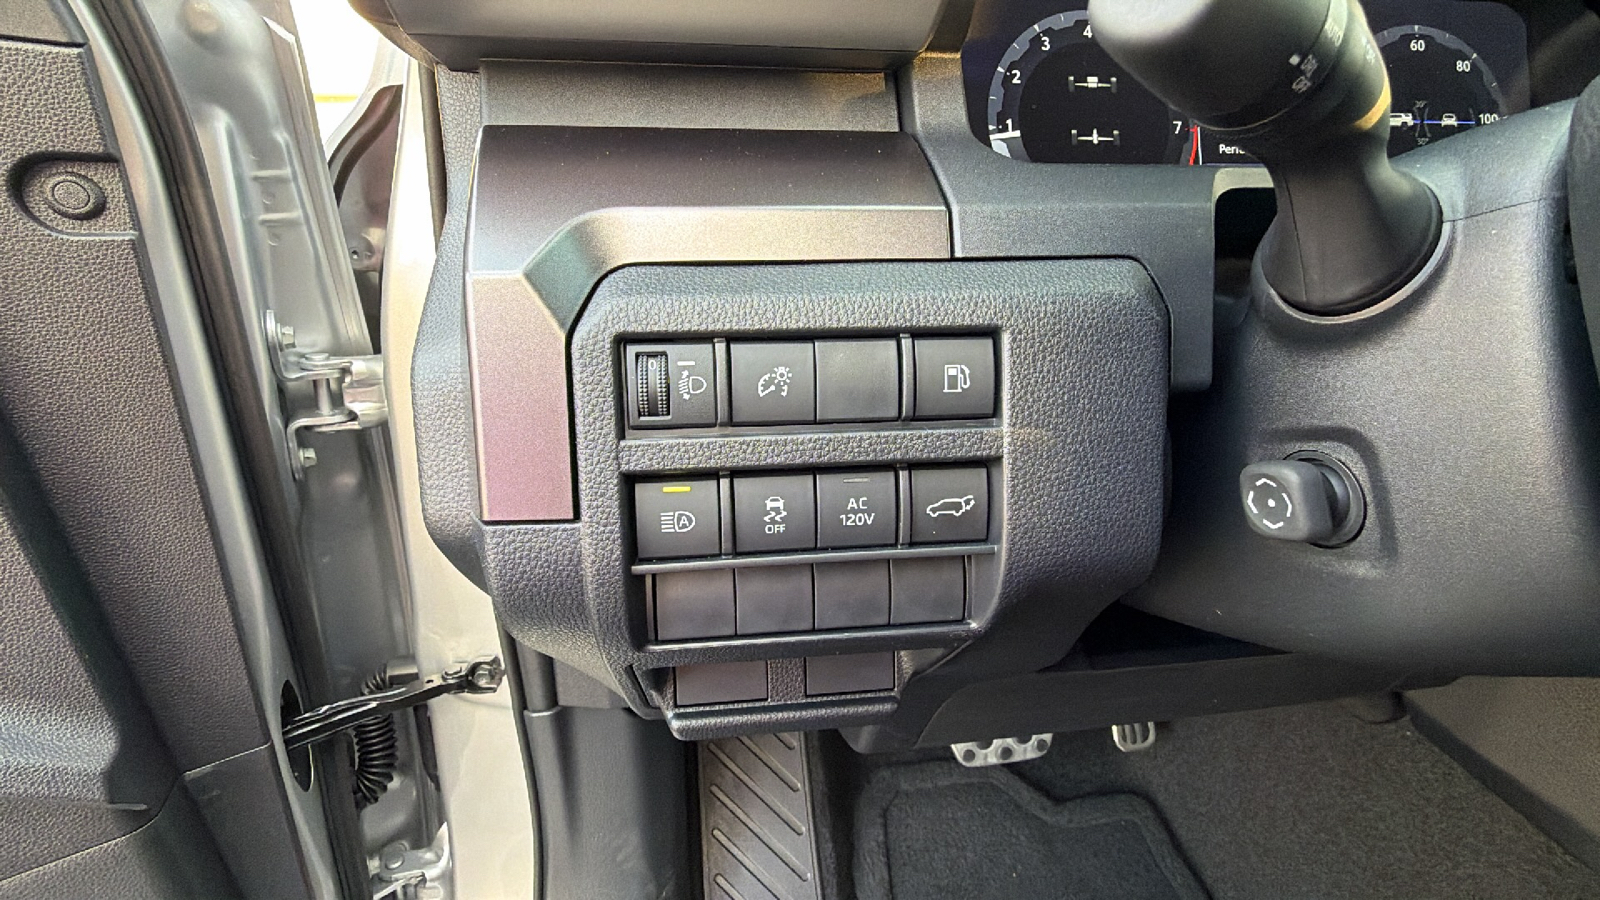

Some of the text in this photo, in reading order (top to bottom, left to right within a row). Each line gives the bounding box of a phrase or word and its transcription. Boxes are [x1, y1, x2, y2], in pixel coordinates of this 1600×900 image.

[1083, 25, 1093, 38] 4
[1041, 38, 1051, 51] 3
[1410, 40, 1425, 51] 60
[1456, 61, 1471, 72] 80
[1012, 70, 1021, 84] 2
[1005, 118, 1013, 132] 1
[1479, 113, 1498, 125] 100
[1173, 121, 1182, 134] 7
[847, 498, 867, 510] AC
[839, 513, 875, 526] 120V
[765, 524, 786, 534] OFF
